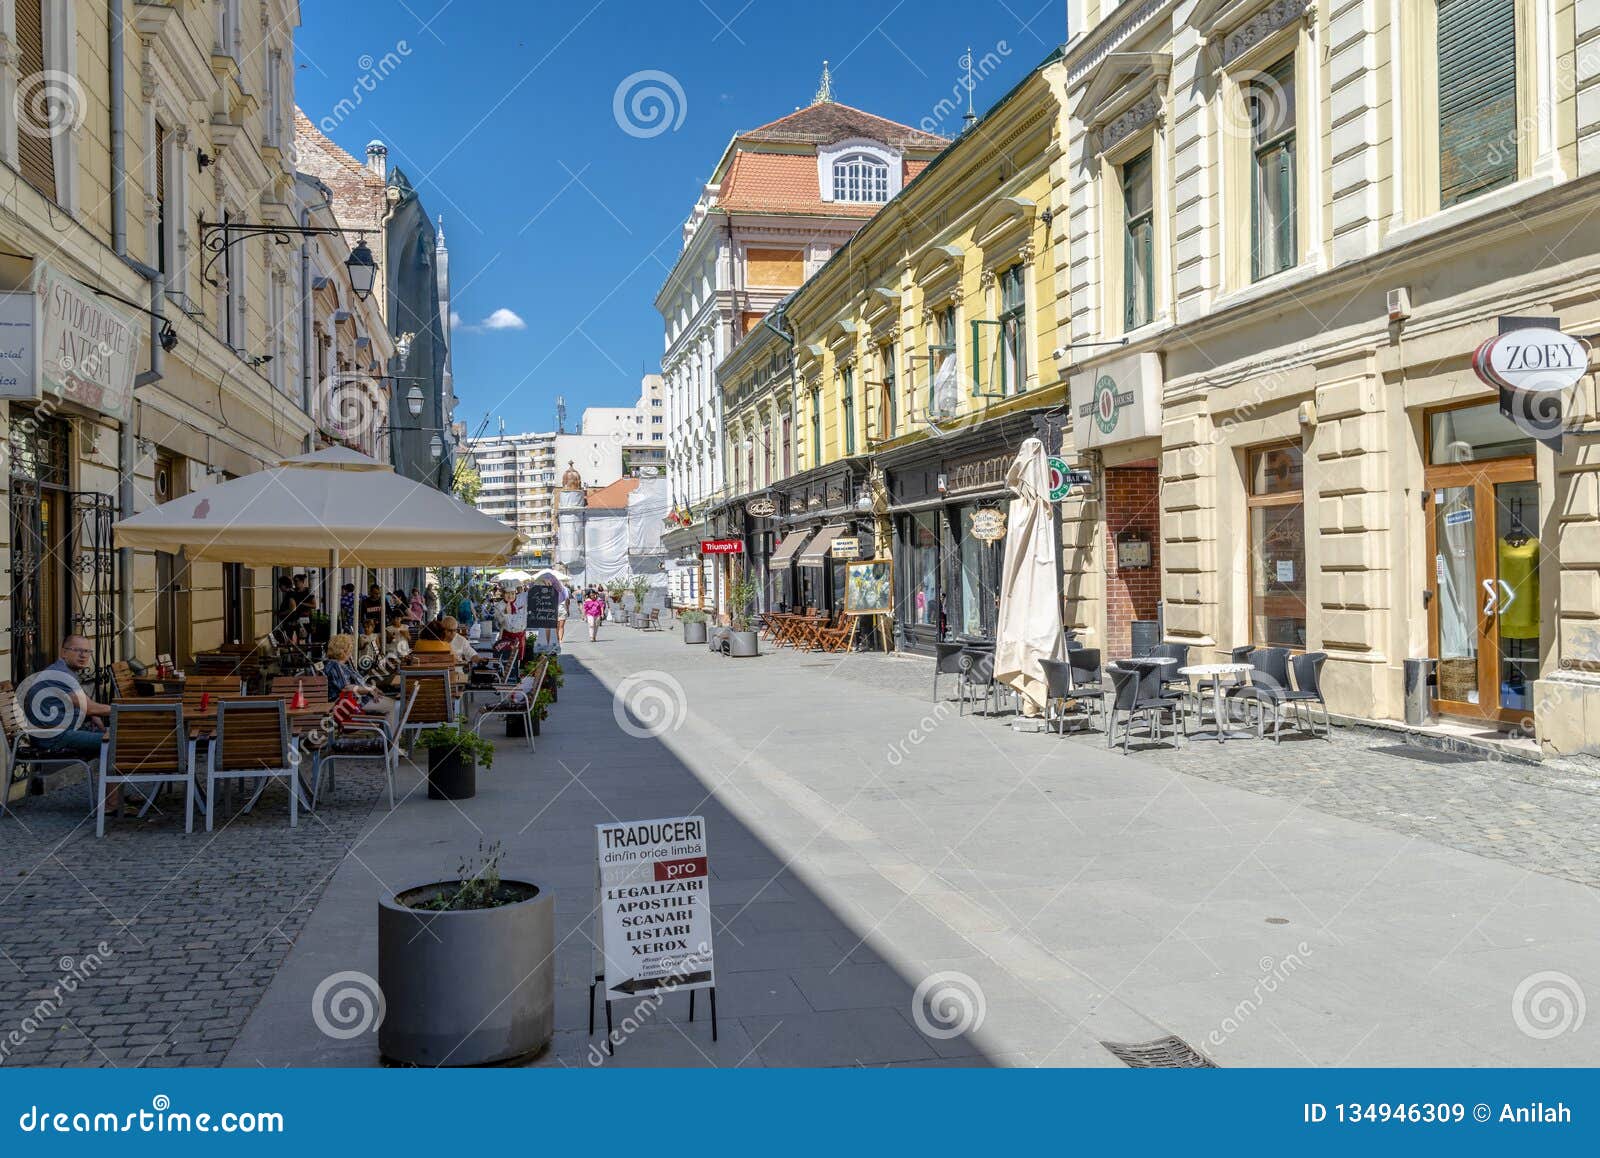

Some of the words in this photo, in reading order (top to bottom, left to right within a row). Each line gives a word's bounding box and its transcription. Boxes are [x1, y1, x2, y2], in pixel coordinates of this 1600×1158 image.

[1506, 343, 1579, 369] ZOEY
[1066, 475, 1080, 483] BAR
[705, 543, 733, 551] Triumph
[602, 820, 702, 849] TRADUCERI
[639, 848, 668, 859] orice
[671, 843, 702, 855] limbă
[667, 862, 697, 879] pro
[607, 879, 704, 900] LEGALIZARI
[616, 895, 697, 913] APOSTILE
[621, 909, 694, 928] SCANARI
[626, 924, 691, 941] LISTARI
[631, 939, 688, 956] XEROX
